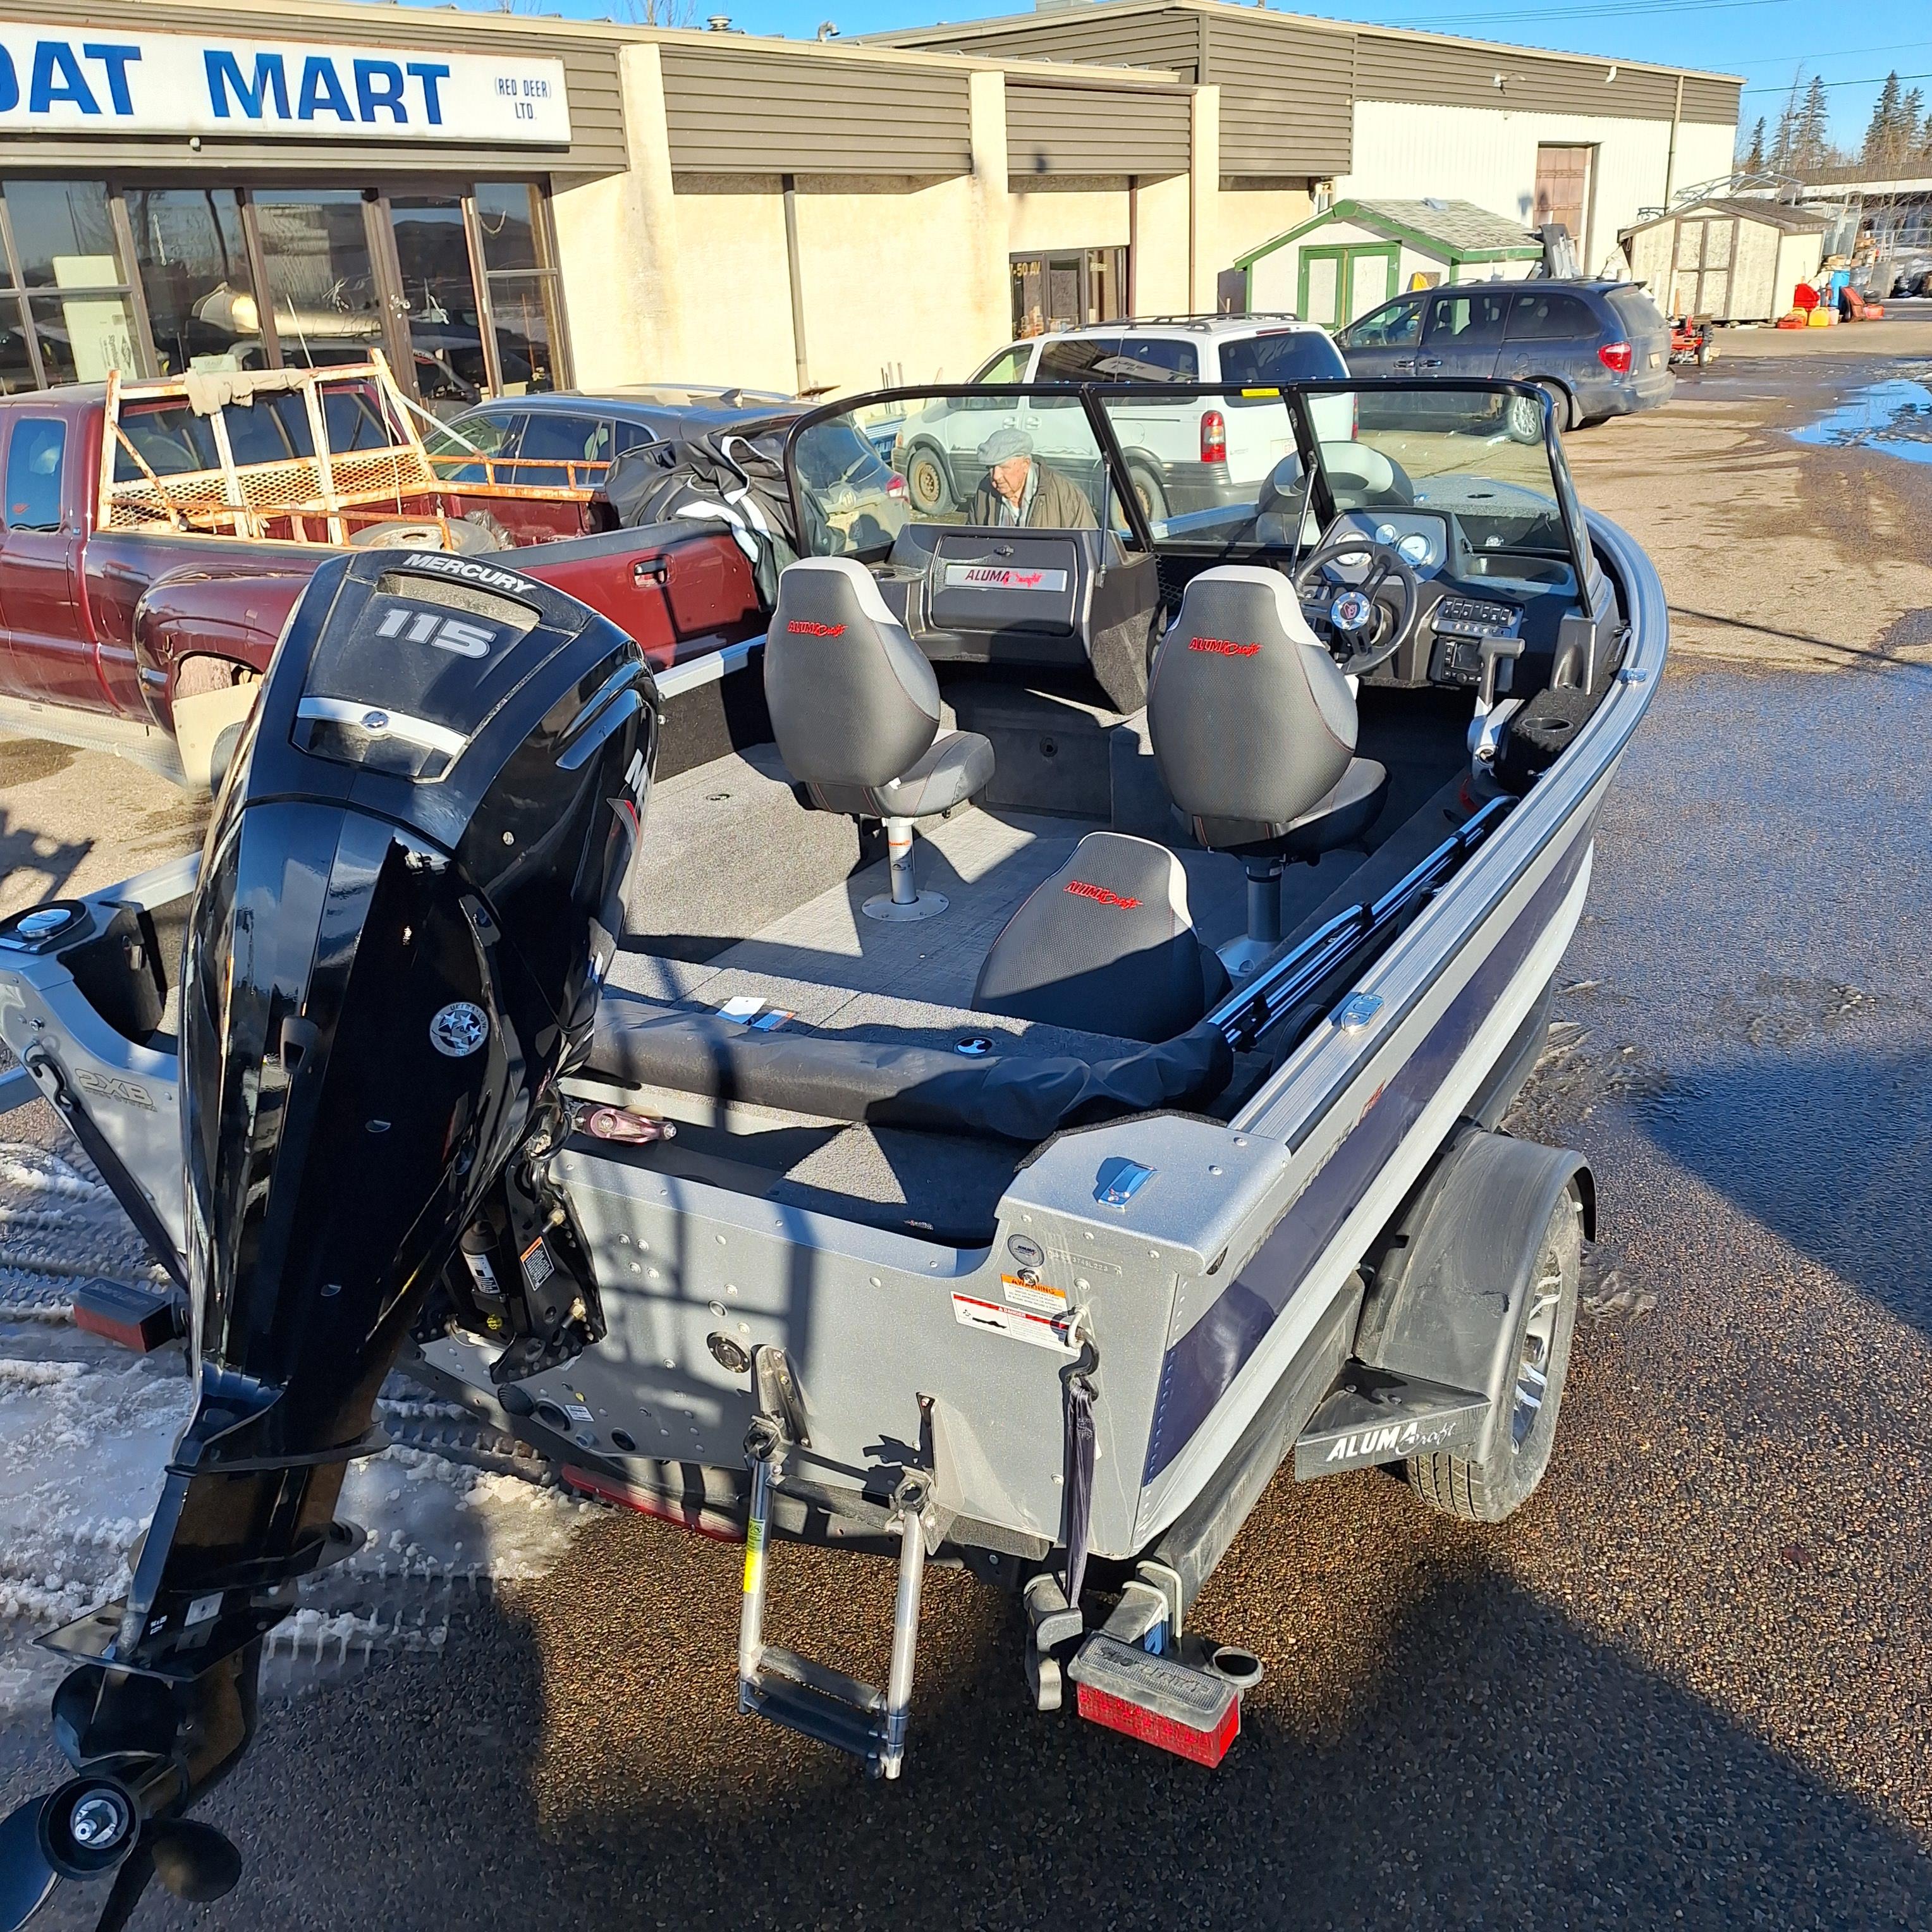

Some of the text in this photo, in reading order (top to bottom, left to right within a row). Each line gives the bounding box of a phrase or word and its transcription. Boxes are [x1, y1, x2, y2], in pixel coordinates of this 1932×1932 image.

[203, 50, 450, 125] MART
[494, 76, 552, 99] (RED DEER)
[515, 102, 537, 120] LTD.
[403, 553, 537, 593] MERCURY
[375, 608, 496, 659] 115
[75, 1068, 154, 1106] 2XB
[1003, 1307, 1026, 1319] DANGER
